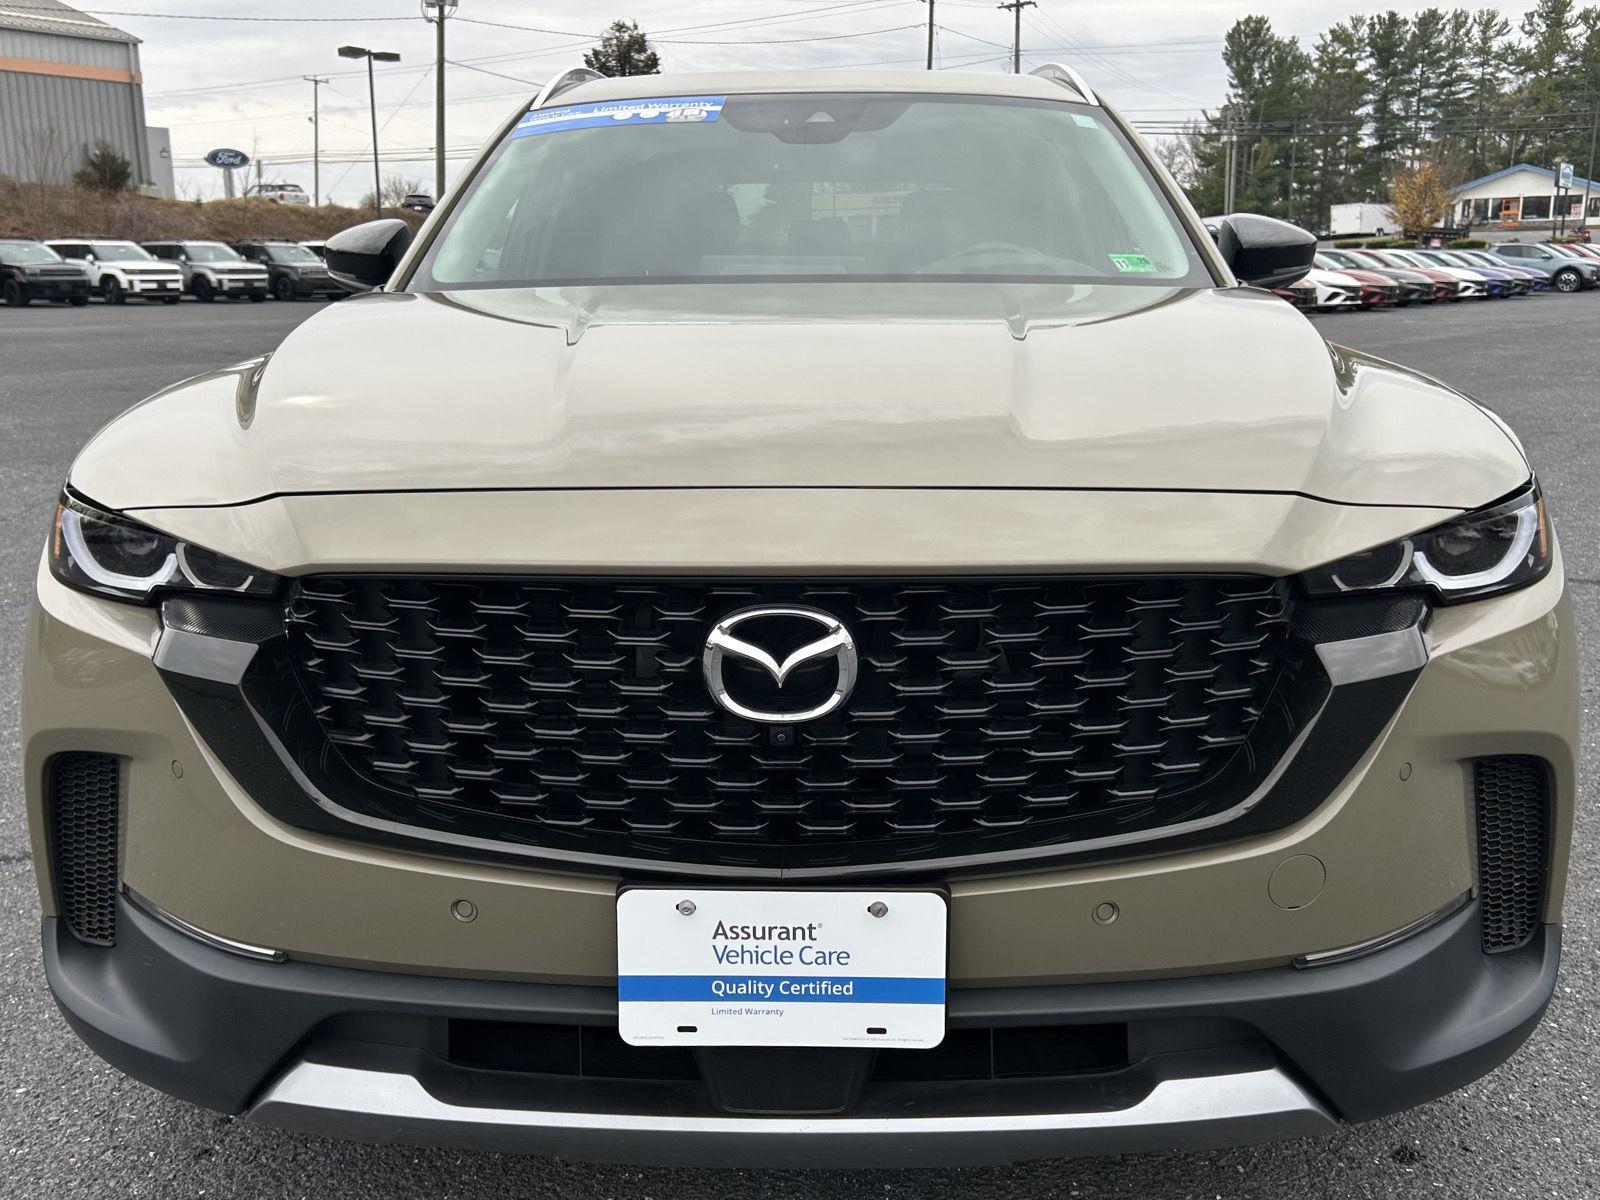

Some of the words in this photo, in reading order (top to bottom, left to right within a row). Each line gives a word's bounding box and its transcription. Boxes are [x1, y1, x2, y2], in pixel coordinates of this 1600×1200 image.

[593, 104, 645, 112] Limited
[649, 101, 713, 109] Warranty
[216, 152, 242, 164] Ford
[712, 944, 794, 965] Vehicle
[799, 946, 850, 966] Care
[712, 980, 774, 998] Quality
[779, 981, 853, 995] Certified
[712, 1008, 743, 1016] Limited
[745, 1008, 784, 1017] Warranty
